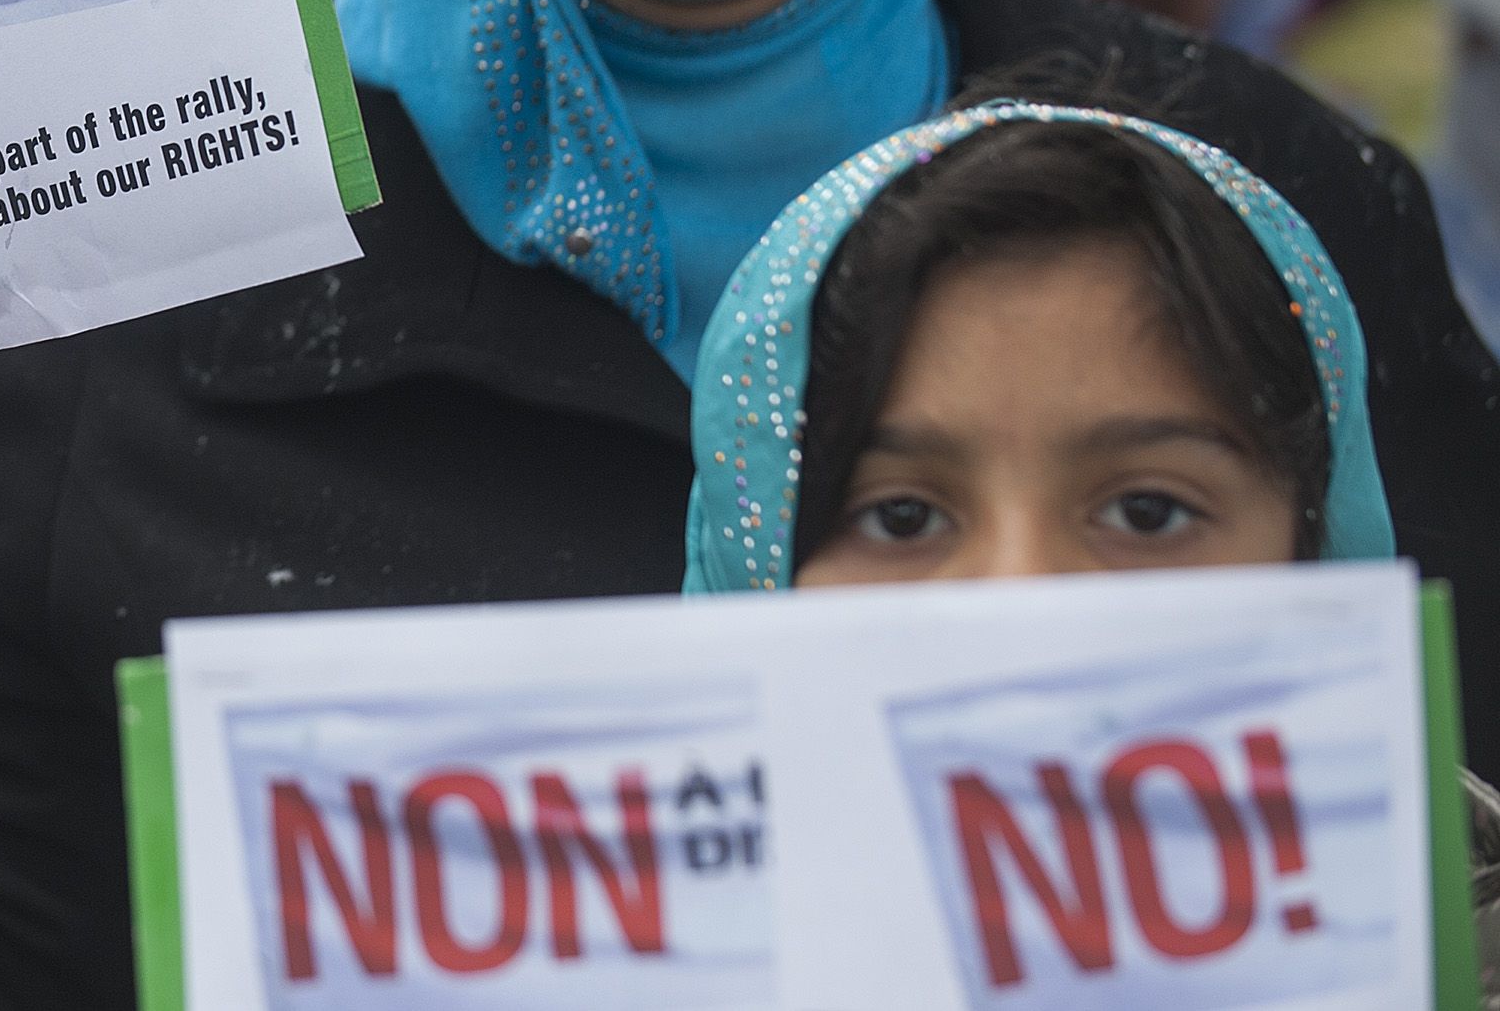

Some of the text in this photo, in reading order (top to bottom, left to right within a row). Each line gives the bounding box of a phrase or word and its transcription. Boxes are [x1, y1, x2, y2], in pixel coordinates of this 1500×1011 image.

[65, 112, 100, 154] of
[109, 102, 166, 142] the
[175, 74, 266, 124] rally,
[95, 157, 152, 198] our
[160, 110, 301, 180] RIGHTS!
[266, 765, 669, 983] NON
[948, 727, 1320, 989] NO!
